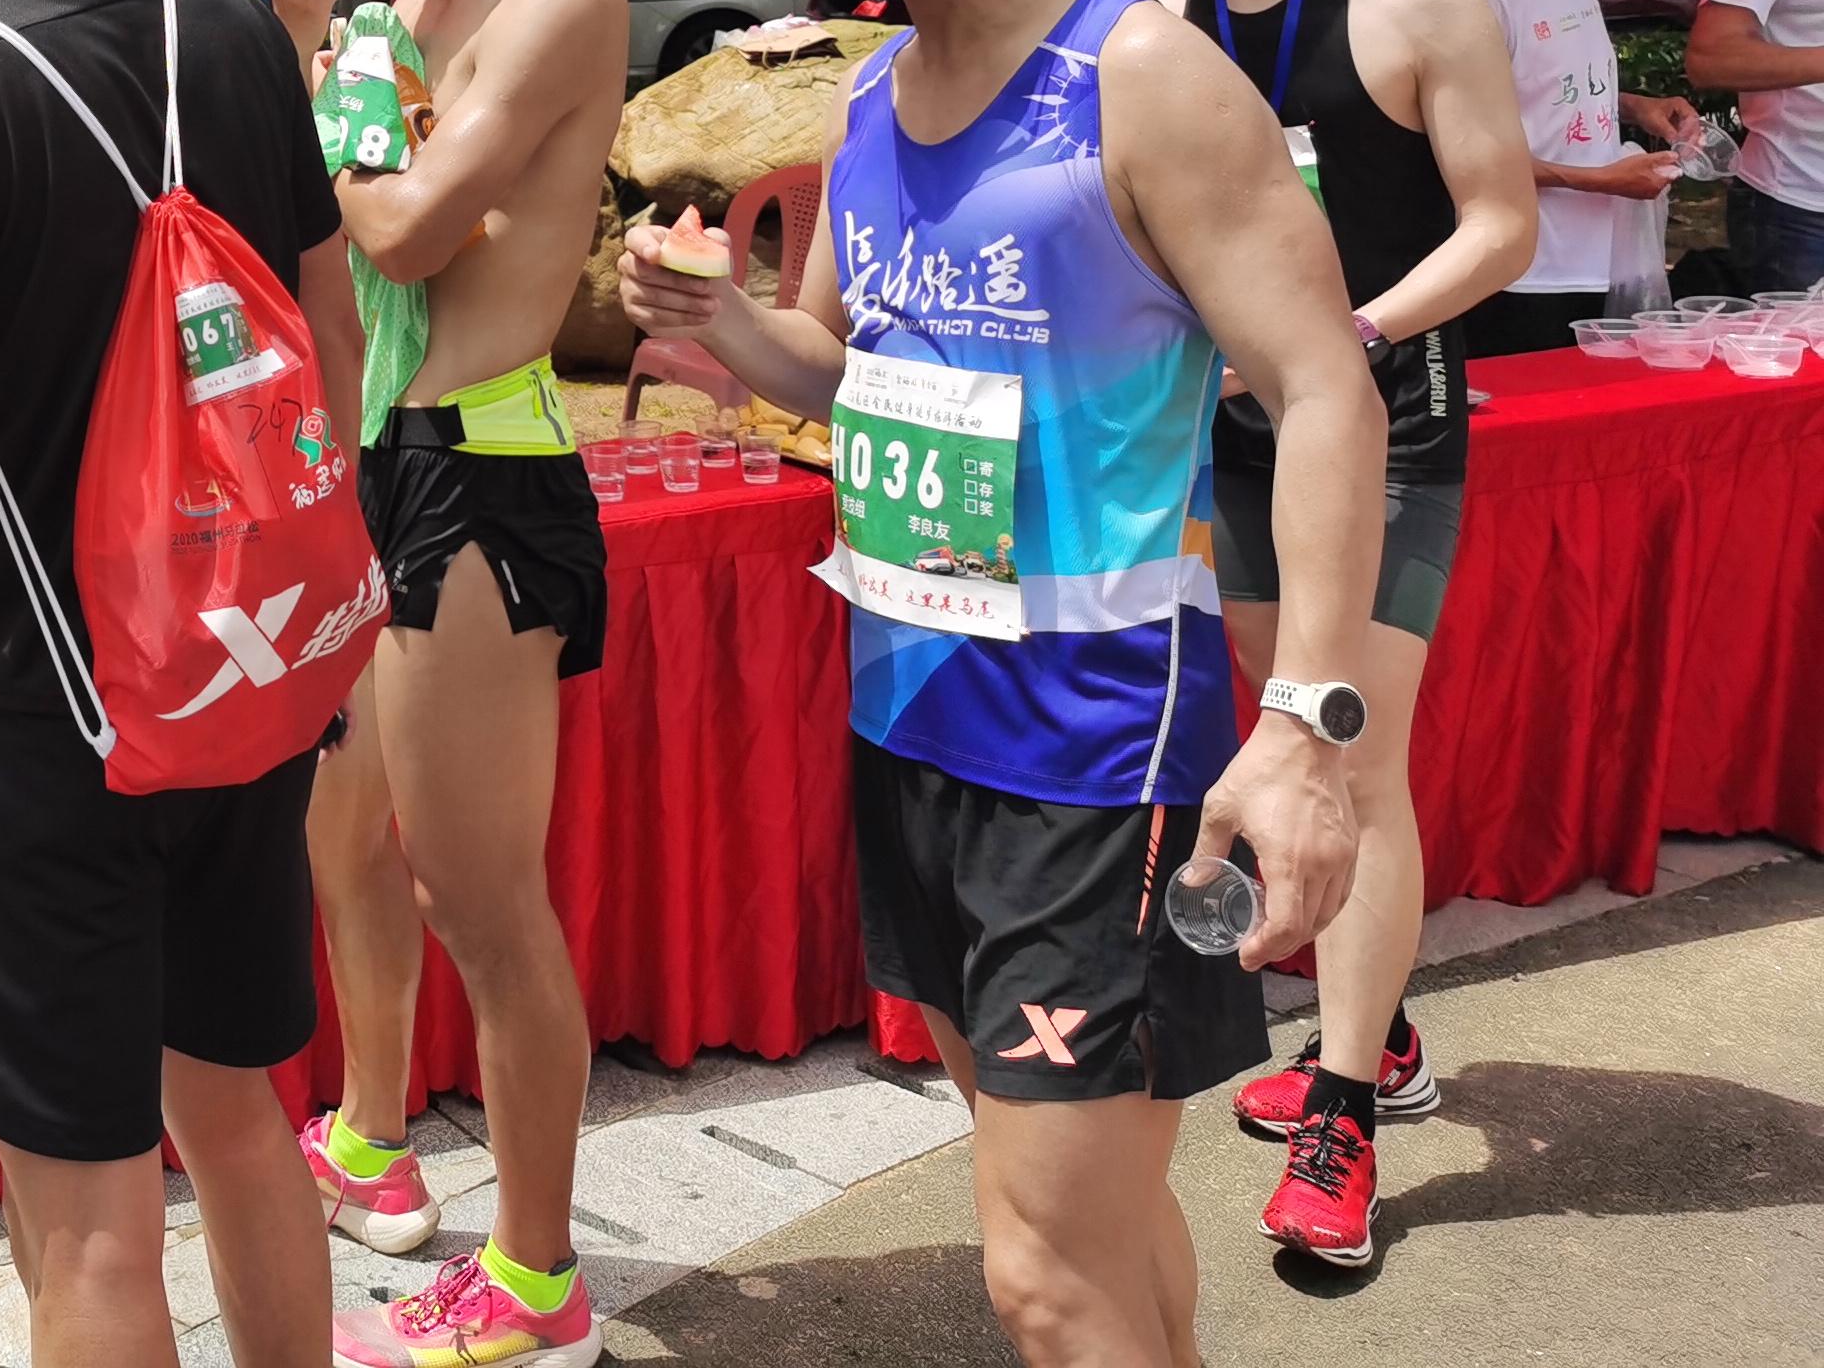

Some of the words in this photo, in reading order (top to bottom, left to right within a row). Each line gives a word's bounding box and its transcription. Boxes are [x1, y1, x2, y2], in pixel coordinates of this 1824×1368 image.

[980, 321, 1051, 344] CLUB
[907, 514, 951, 542] 李良友
